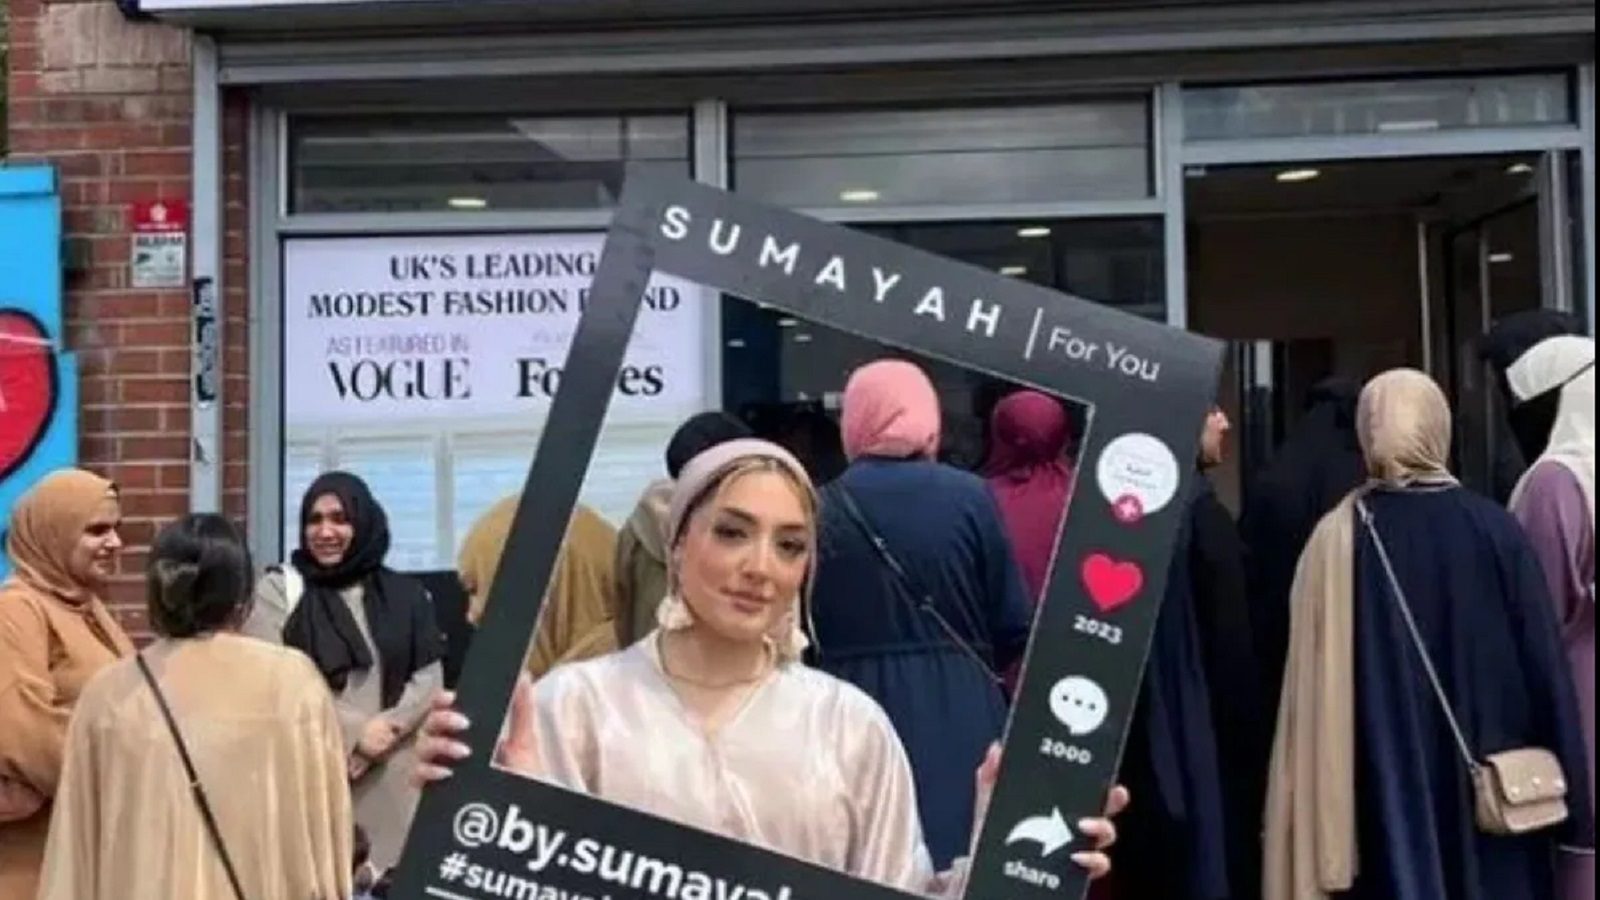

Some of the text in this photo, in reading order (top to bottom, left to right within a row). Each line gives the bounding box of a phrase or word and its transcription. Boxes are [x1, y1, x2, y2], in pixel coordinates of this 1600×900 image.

[389, 252, 596, 281] UK'S LEADING
[307, 291, 436, 318] MODEST
[444, 288, 567, 316] FASHION
[660, 205, 1002, 338] SUMAYAH
[1047, 325, 1099, 361] For
[1105, 342, 1160, 382] You
[328, 357, 472, 402] VOGUE
[516, 357, 665, 398] Foes
[1073, 614, 1123, 645] 2023
[1039, 737, 1092, 765] 2000
[438, 851, 612, 900] #suma
[1003, 859, 1061, 890] share
